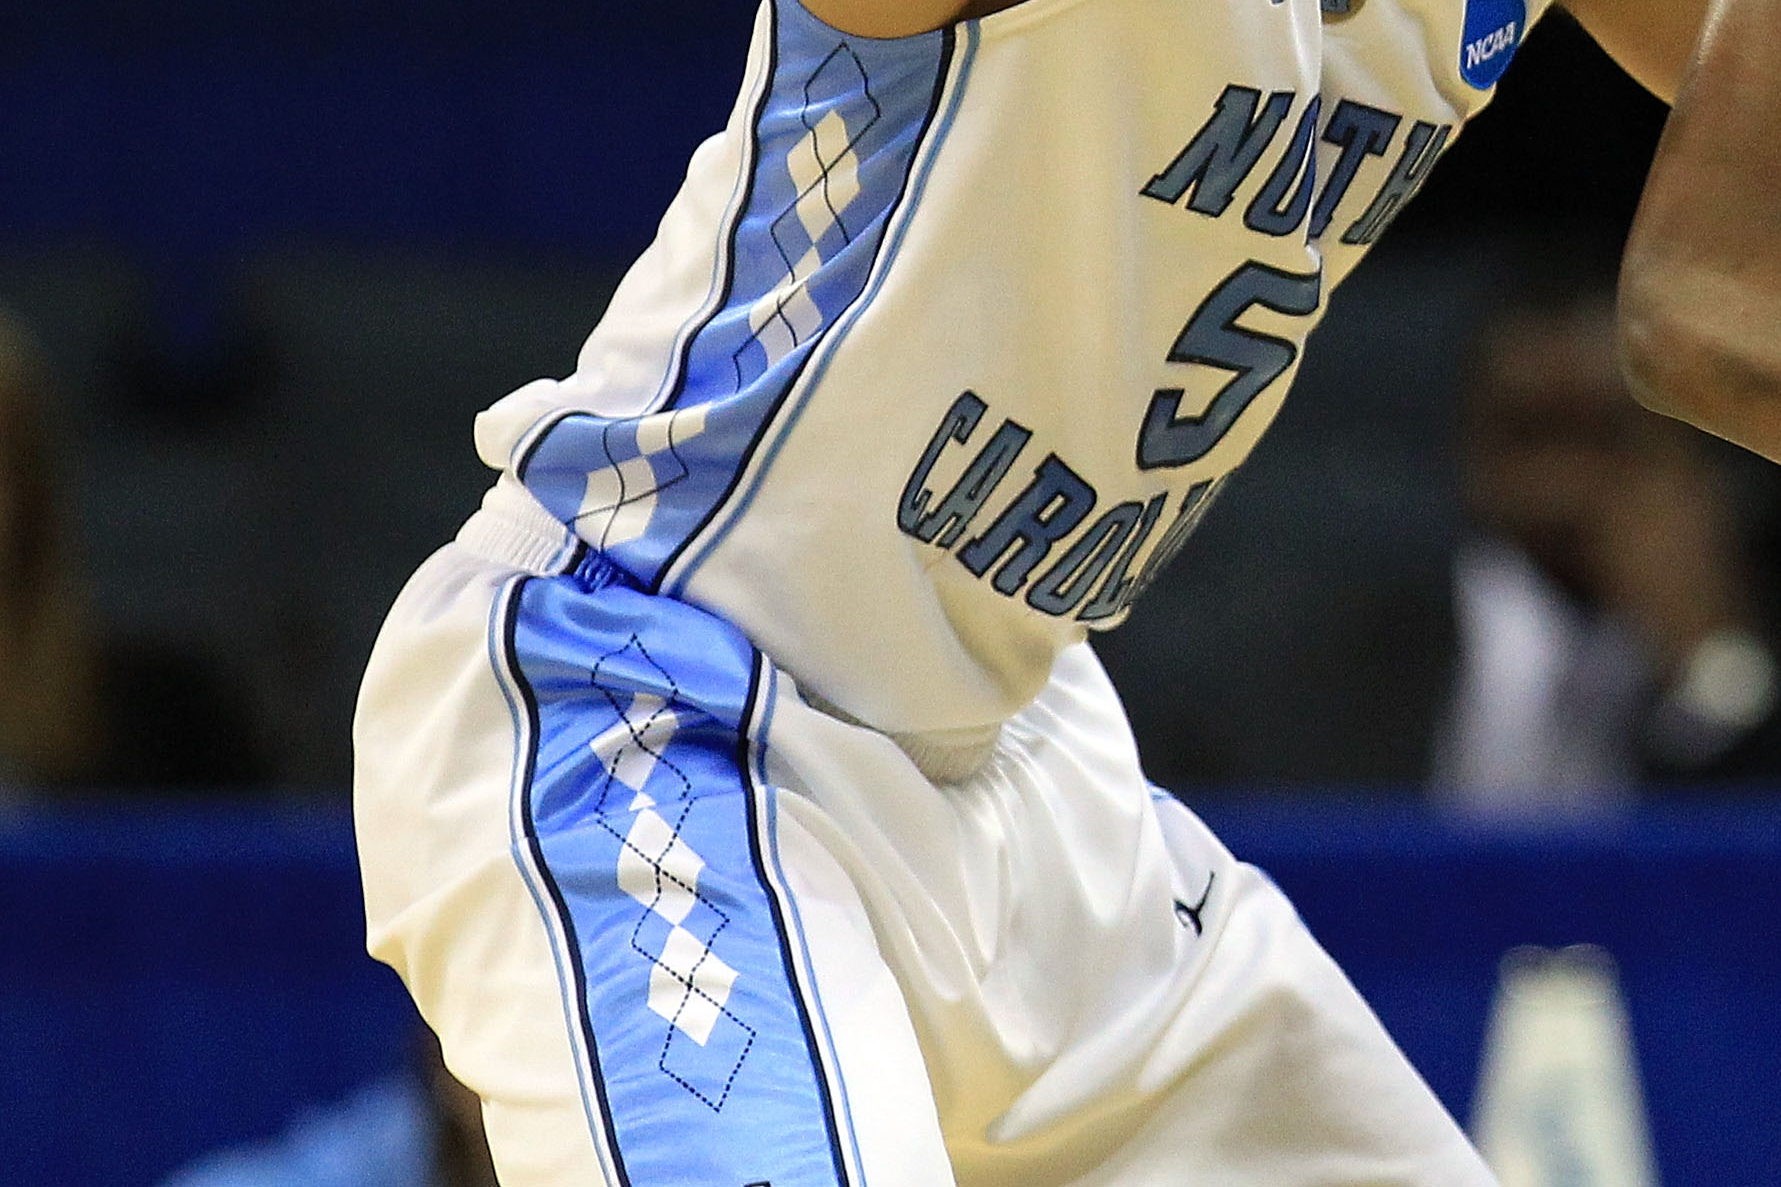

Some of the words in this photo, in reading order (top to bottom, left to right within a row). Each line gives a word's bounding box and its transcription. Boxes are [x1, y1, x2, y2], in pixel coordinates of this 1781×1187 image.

[1465, 22, 1517, 70] NCAA
[1138, 82, 1454, 245] NOTH
[1135, 258, 1323, 472] 5
[896, 388, 1215, 623] CAROL
